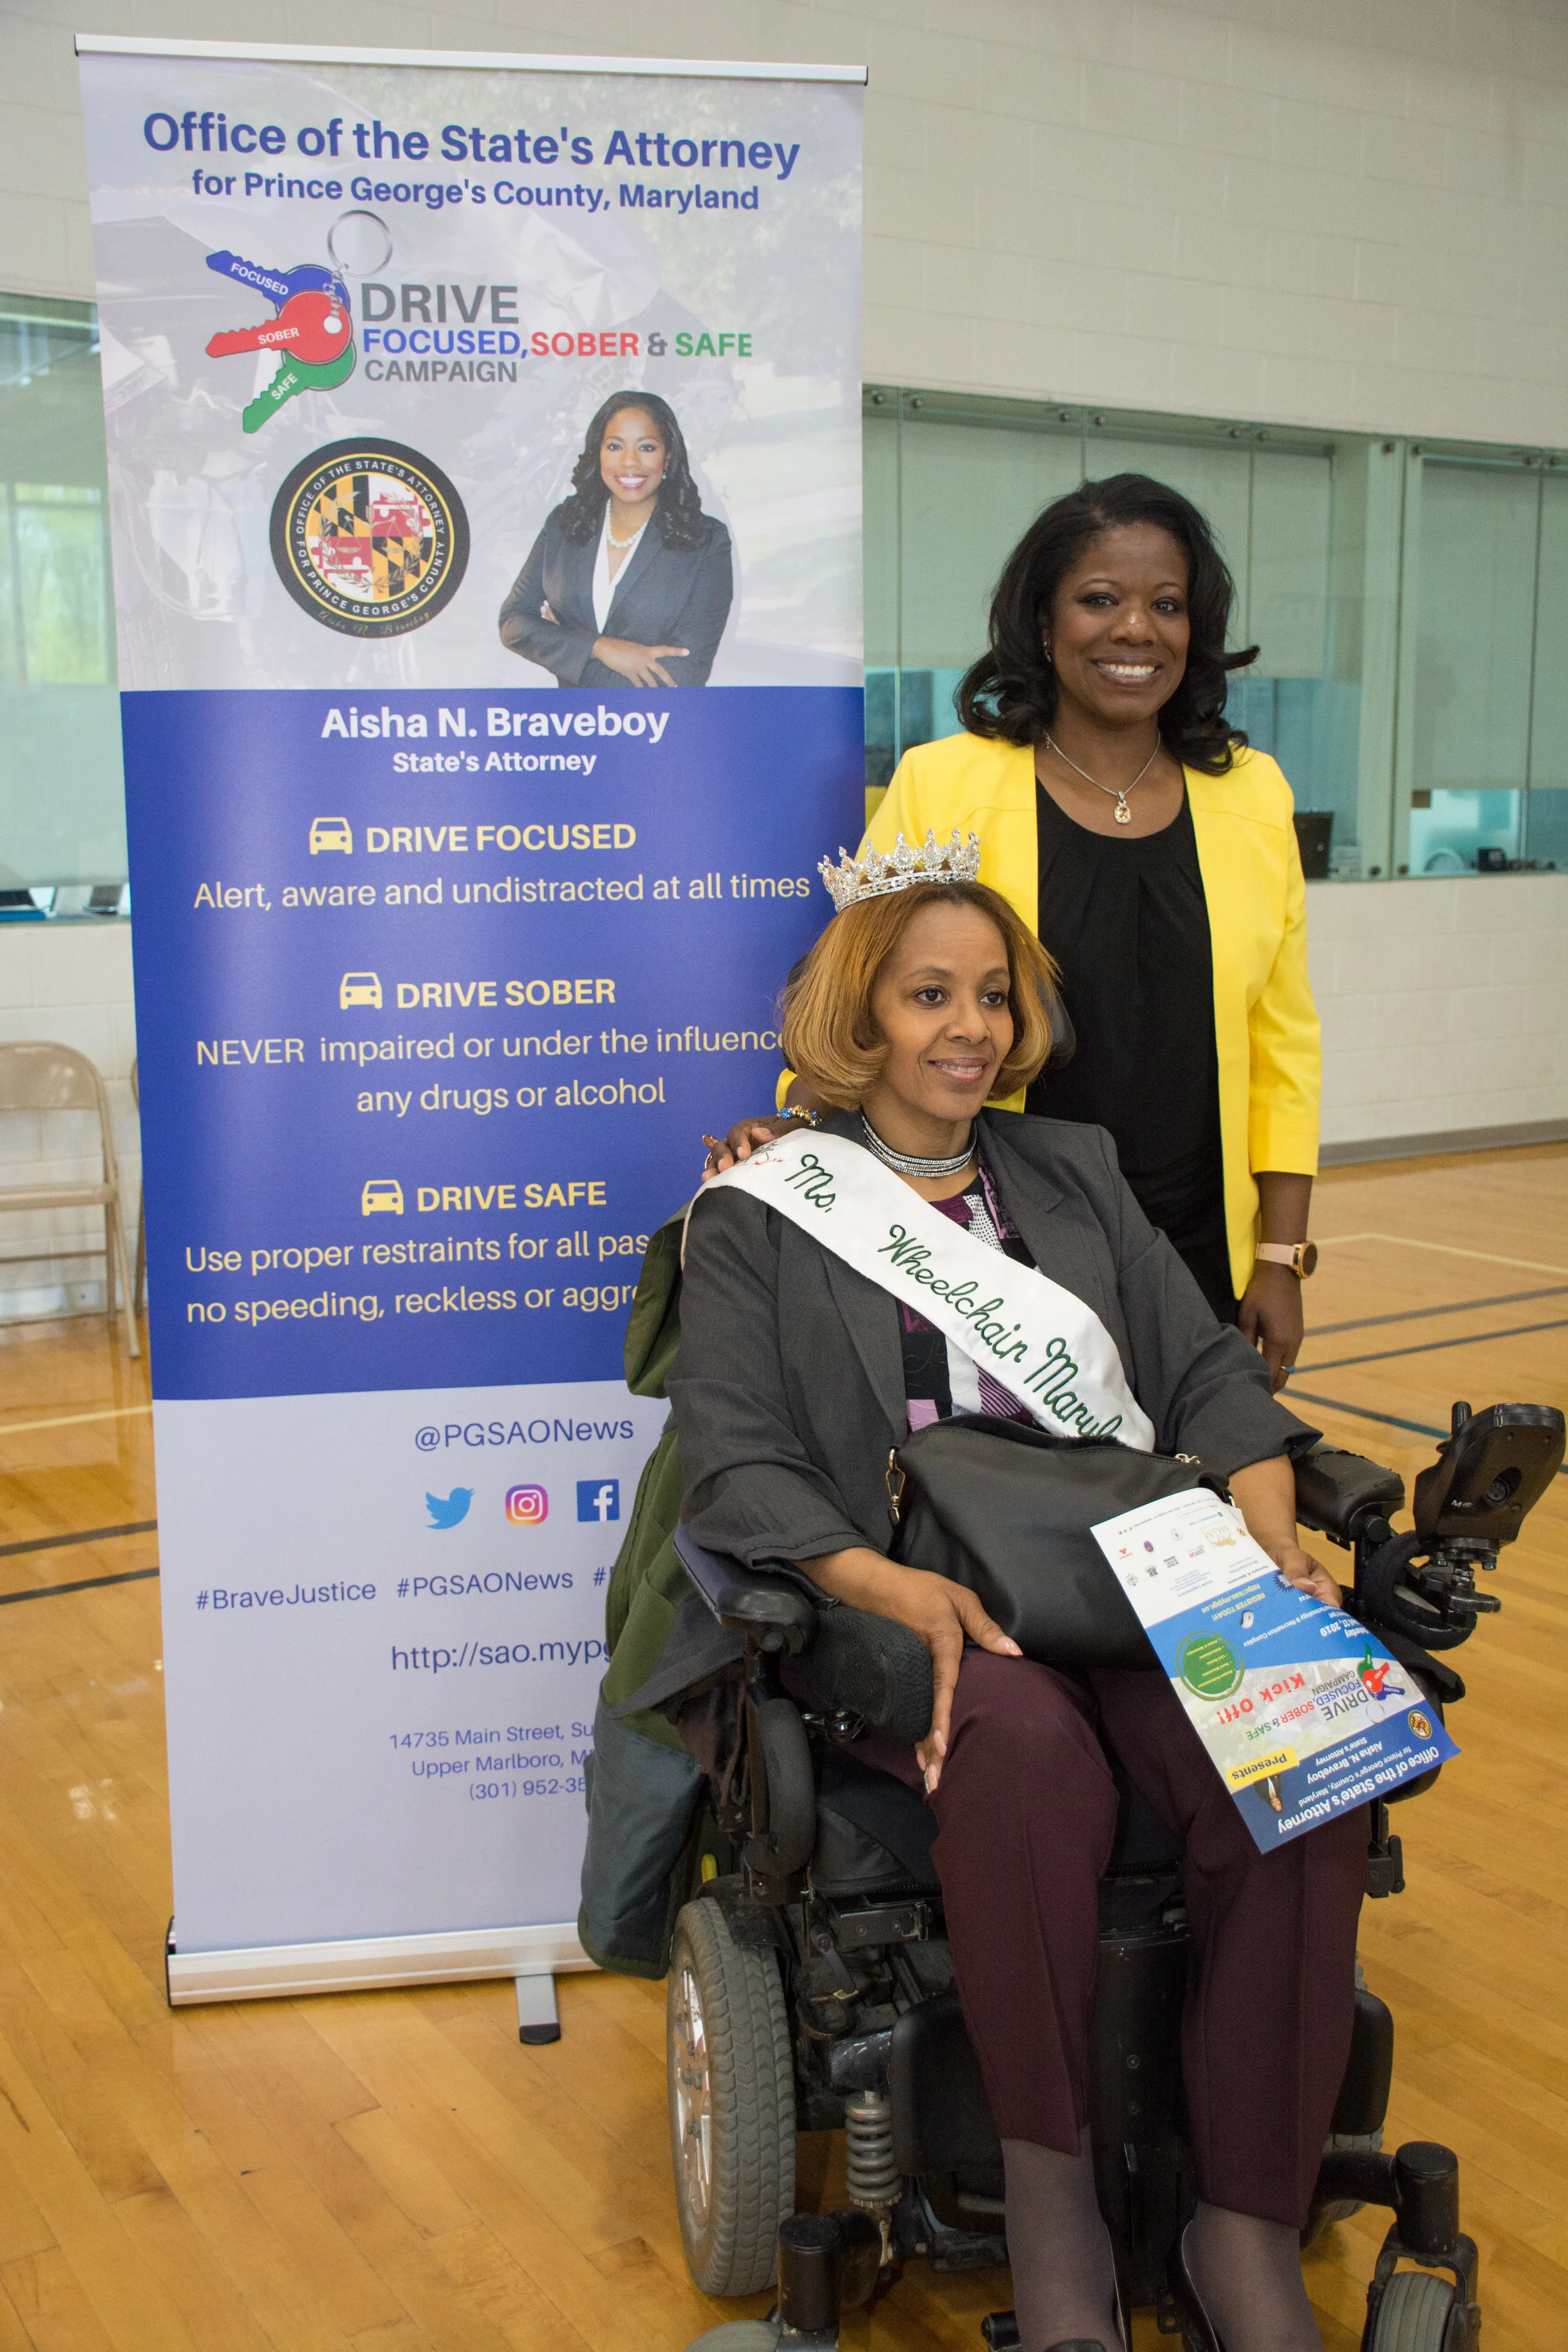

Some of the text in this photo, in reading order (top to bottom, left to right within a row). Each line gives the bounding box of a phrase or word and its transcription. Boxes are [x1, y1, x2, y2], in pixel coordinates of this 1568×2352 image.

[143, 110, 801, 181] Office of the State's Attorney
[192, 168, 759, 215] for Prince George's County, Maryland
[231, 262, 289, 295] FOCUSED
[361, 282, 519, 324] DRIVE
[258, 327, 300, 345] SOBER
[530, 331, 639, 357] SOBER
[647, 332, 668, 357] &
[675, 332, 752, 358] SAFE
[270, 373, 298, 400] SAFE
[364, 360, 517, 383] CAMPAIGN
[295, 460, 445, 535] OFFICE OF THE STATE'S ATTORNEY
[297, 540, 445, 615] FOR PRINCE GEORGE'S COUNTY
[321, 704, 670, 744] Aisha N. Braveboy
[393, 750, 597, 776] State's Attorney
[366, 824, 637, 853] DRIVE FOCUSED
[191, 872, 810, 913] Alert, aware and undistracted at all times
[396, 978, 616, 1009] DRIVE SOBER
[197, 1024, 783, 1067] NEVER impaired or under the influenc
[356, 1077, 666, 1118] any drugs or alcohol
[417, 1181, 607, 1212] DRIVE SAFE
[186, 1246, 242, 1272] Use
[251, 1245, 354, 1276] proper
[362, 1236, 501, 1264] restraints
[507, 1232, 549, 1259] for
[556, 1230, 590, 1258] all
[187, 1302, 226, 1323] no
[234, 1291, 385, 1327] speeding,
[395, 1285, 517, 1313] reckless
[524, 1288, 555, 1308] or
[877, 1224, 1028, 1364] Wheelchair
[415, 1418, 634, 1452] @PGSAONews
[196, 1581, 376, 1610] #BraveJustice
[397, 1571, 574, 1597] #PGSAONews
[1211, 1592, 1265, 1621] REGISTER TODAY!
[1242, 1633, 1268, 1646] Complex
[1266, 1619, 1296, 1636] Recreation
[1319, 1621, 1341, 1637] 2019
[1311, 1671, 1355, 1695] CAMPAIGN
[1217, 1673, 1305, 1724] Kick Off!
[1279, 1700, 1315, 1724] SOBER
[1321, 1689, 1369, 1720] DRIVE
[389, 1730, 450, 1749] 14735
[455, 1728, 501, 1745] Main
[507, 1724, 564, 1742] Street,
[1245, 1722, 1271, 1740] SAFE
[1272, 1718, 1279, 1726] &
[412, 1749, 595, 1779] Upper Marlboro, M
[1232, 1747, 1286, 1779] Presents
[1307, 1741, 1382, 1783] Aisha N. Braveboy
[1316, 1737, 1367, 1765] State's Attorney
[1383, 1751, 1402, 1762] Prince
[1328, 1775, 1354, 1789] County,
[1354, 1761, 1383, 1777] George's
[469, 1780, 517, 1801] (301)
[1278, 1747, 1438, 1833] Office of the State's Attorney
[1298, 1788, 1328, 1806] Maryland
